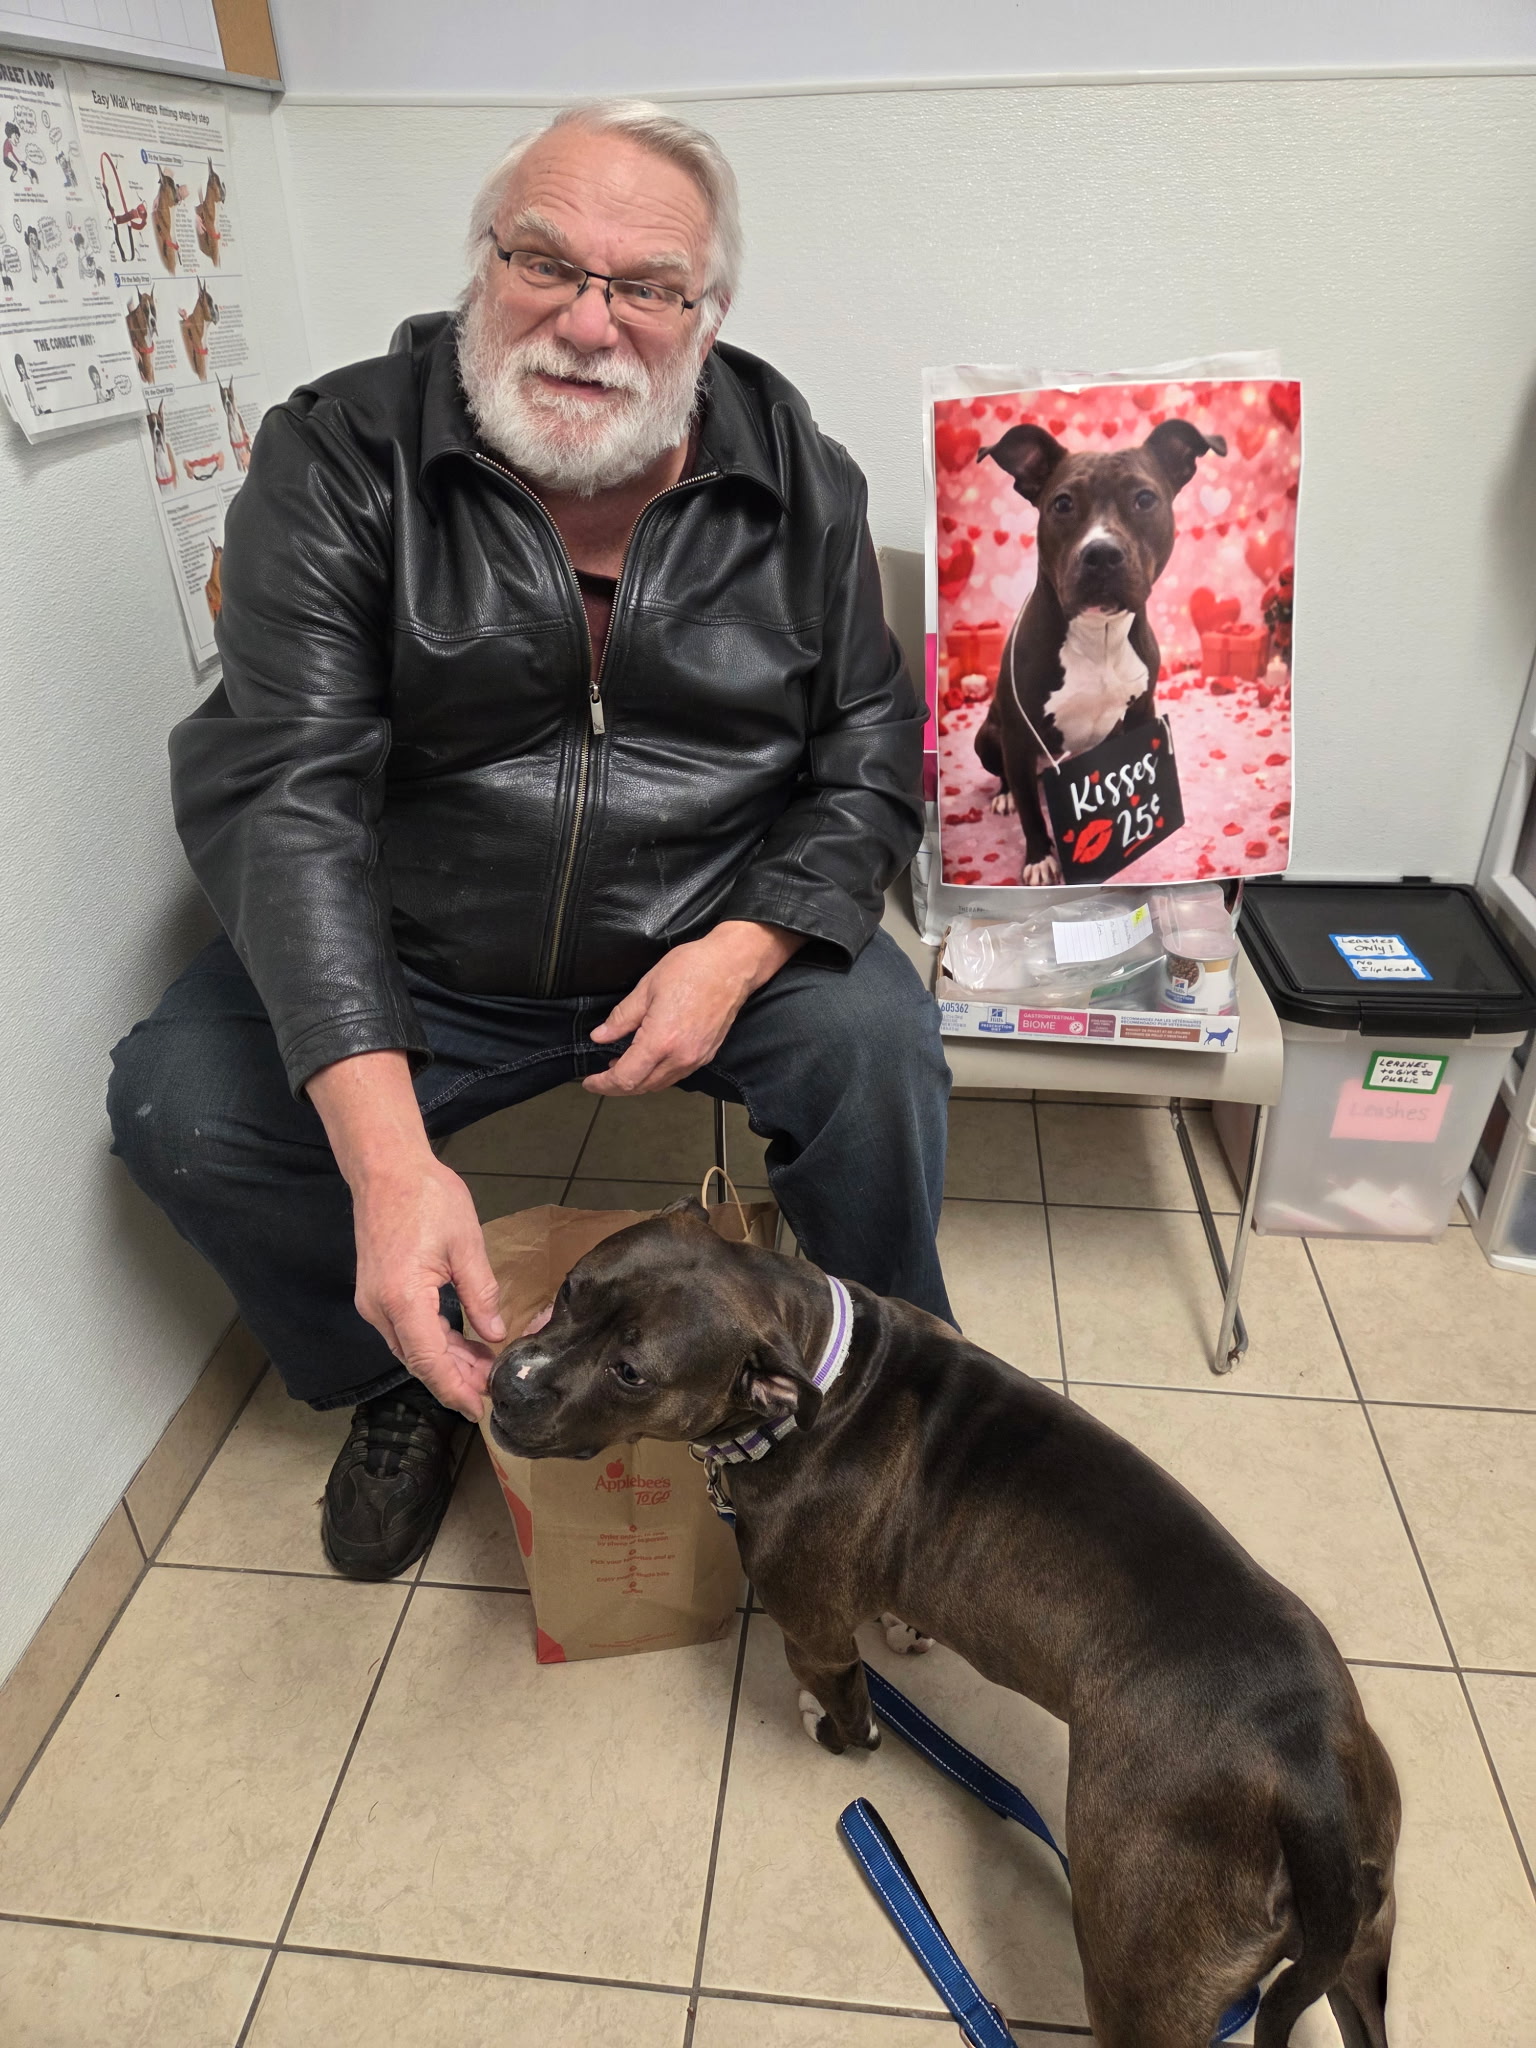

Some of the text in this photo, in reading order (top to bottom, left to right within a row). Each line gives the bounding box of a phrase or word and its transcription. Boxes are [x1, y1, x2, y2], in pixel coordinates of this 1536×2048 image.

[27, 69, 36, 86] A
[34, 70, 54, 89] DOG
[92, 90, 109, 109] Easy
[129, 97, 158, 115] Harness
[179, 110, 190, 122] step
[191, 110, 198, 124] by
[199, 114, 210, 126] step
[33, 338, 50, 352] THE
[50, 335, 78, 350] CORRECT
[1070, 753, 1158, 820] Kisses
[941, 1002, 969, 1013] 605362
[1022, 1020, 1056, 1030] BIOME
[1421, 1069, 1434, 1077] to
[1349, 1100, 1431, 1121] Leashes
[595, 1474, 672, 1493] Applebee's
